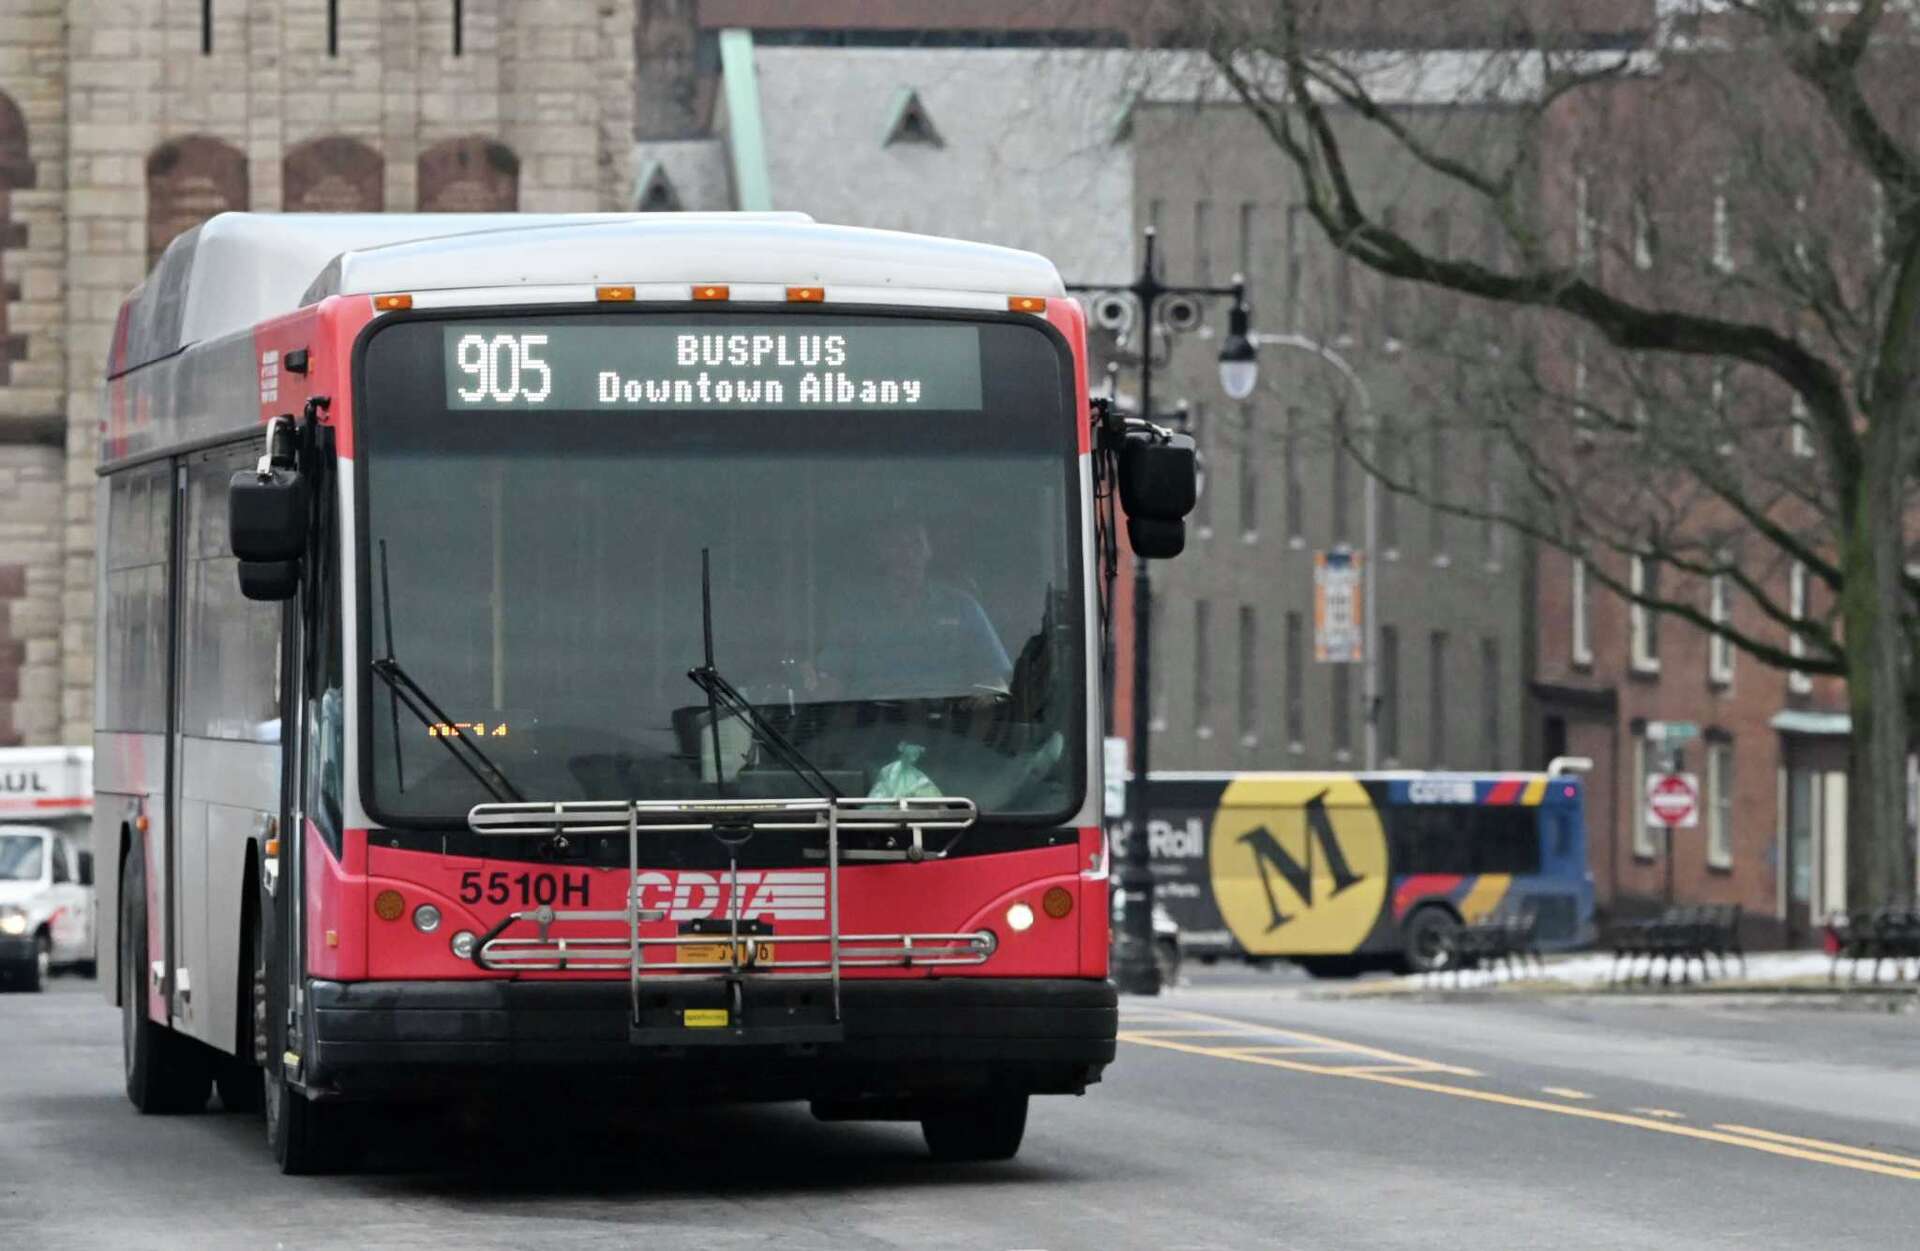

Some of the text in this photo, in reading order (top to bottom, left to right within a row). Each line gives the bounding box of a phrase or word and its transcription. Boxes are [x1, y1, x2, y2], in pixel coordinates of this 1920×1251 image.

[458, 334, 551, 402] 905
[677, 335, 846, 366] BUSPLUS
[599, 371, 921, 403] Downtown Albany
[0, 770, 48, 793] UL
[1147, 818, 1204, 858] Roll
[1236, 787, 1365, 934] M
[460, 872, 590, 906] 5510H
[626, 872, 825, 920] CDTA
